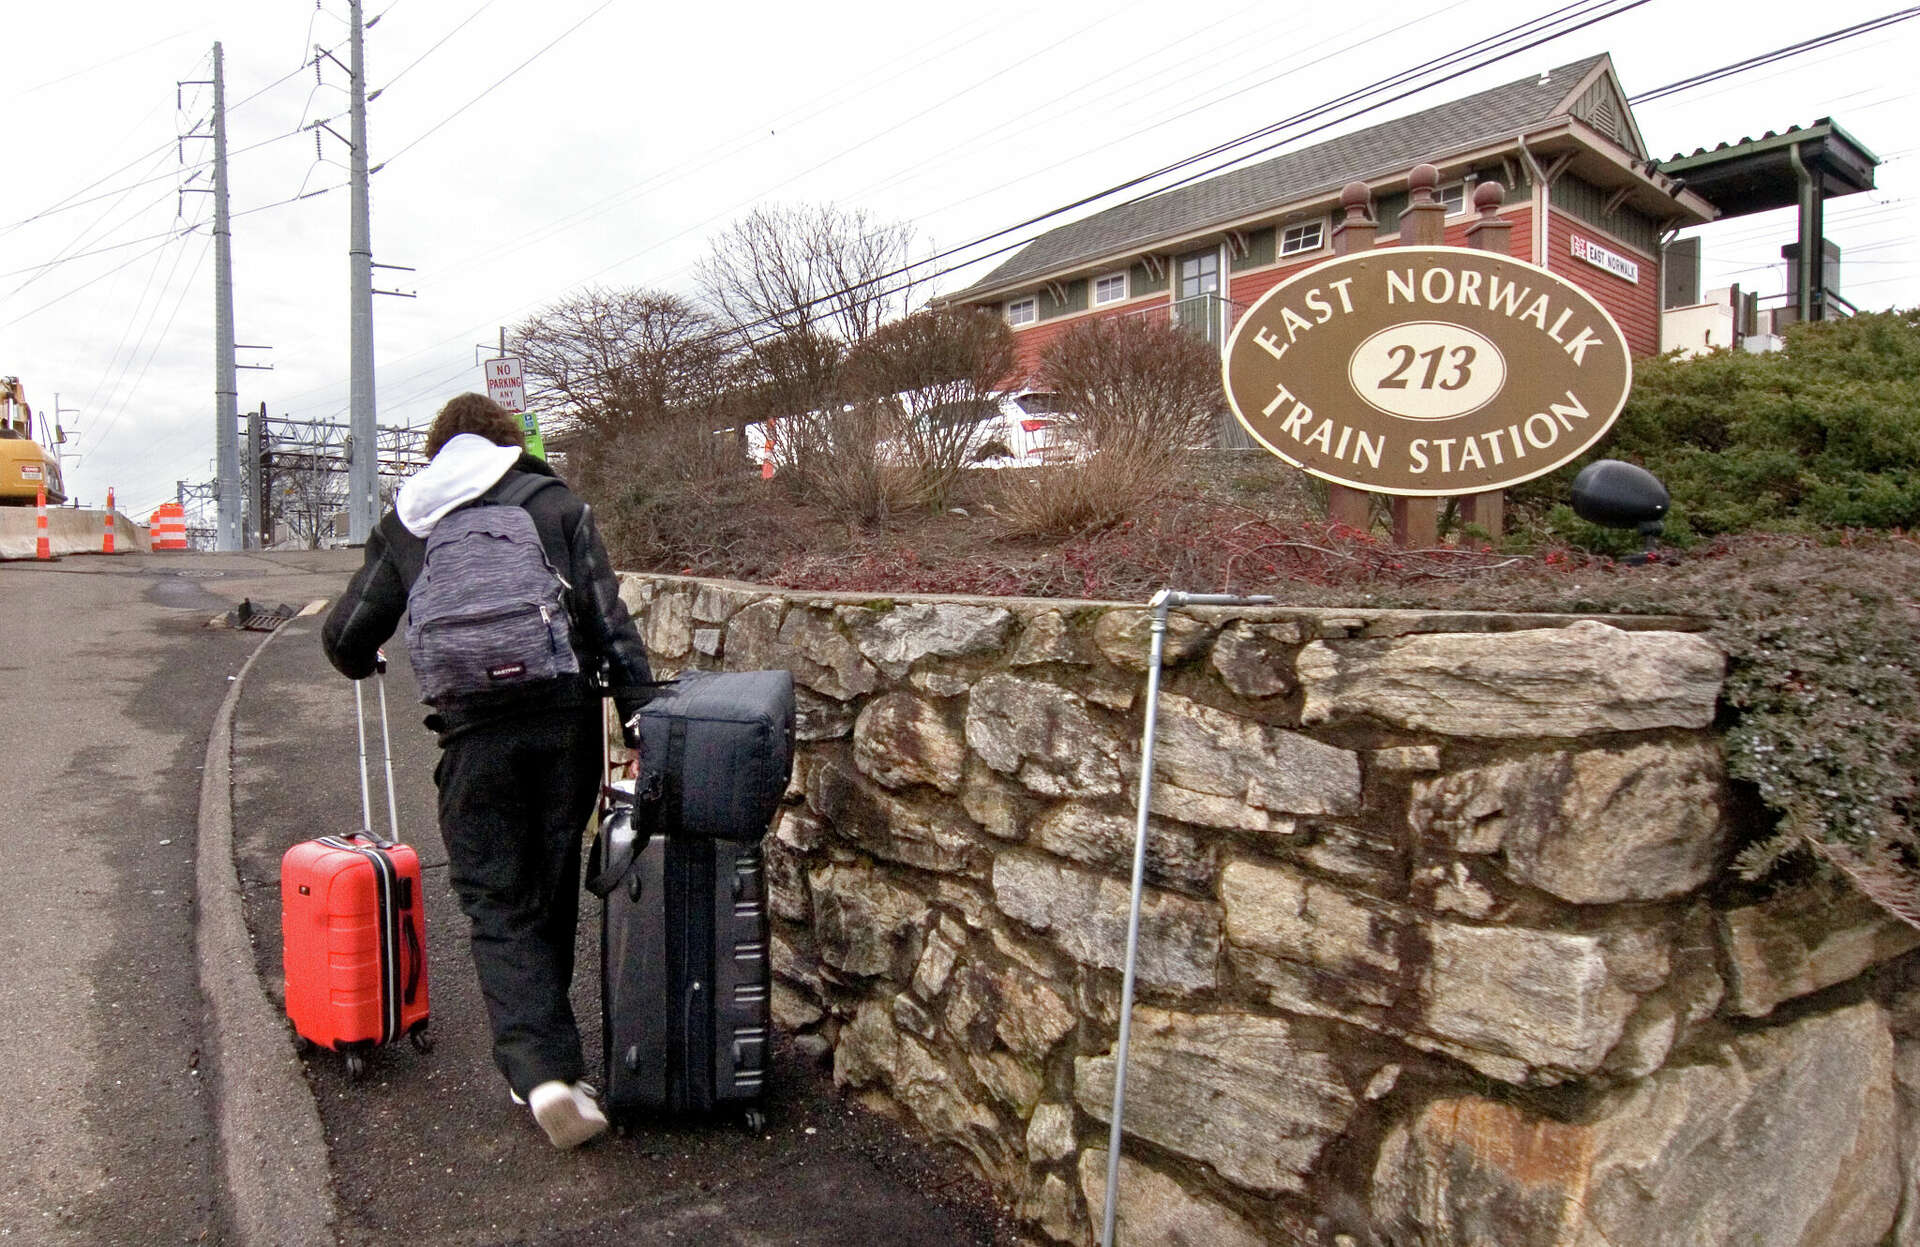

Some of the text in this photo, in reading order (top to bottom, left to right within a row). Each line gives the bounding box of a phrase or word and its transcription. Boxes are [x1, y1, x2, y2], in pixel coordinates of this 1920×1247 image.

[1589, 246, 1605, 264] EAST
[1607, 255, 1636, 279] NORWALK
[1253, 267, 1604, 368] EAST NORWALK
[488, 377, 521, 389] PARKING
[497, 364, 511, 375] NO
[1377, 345, 1477, 390] 213
[1262, 384, 1590, 474] TRAIN STATION
